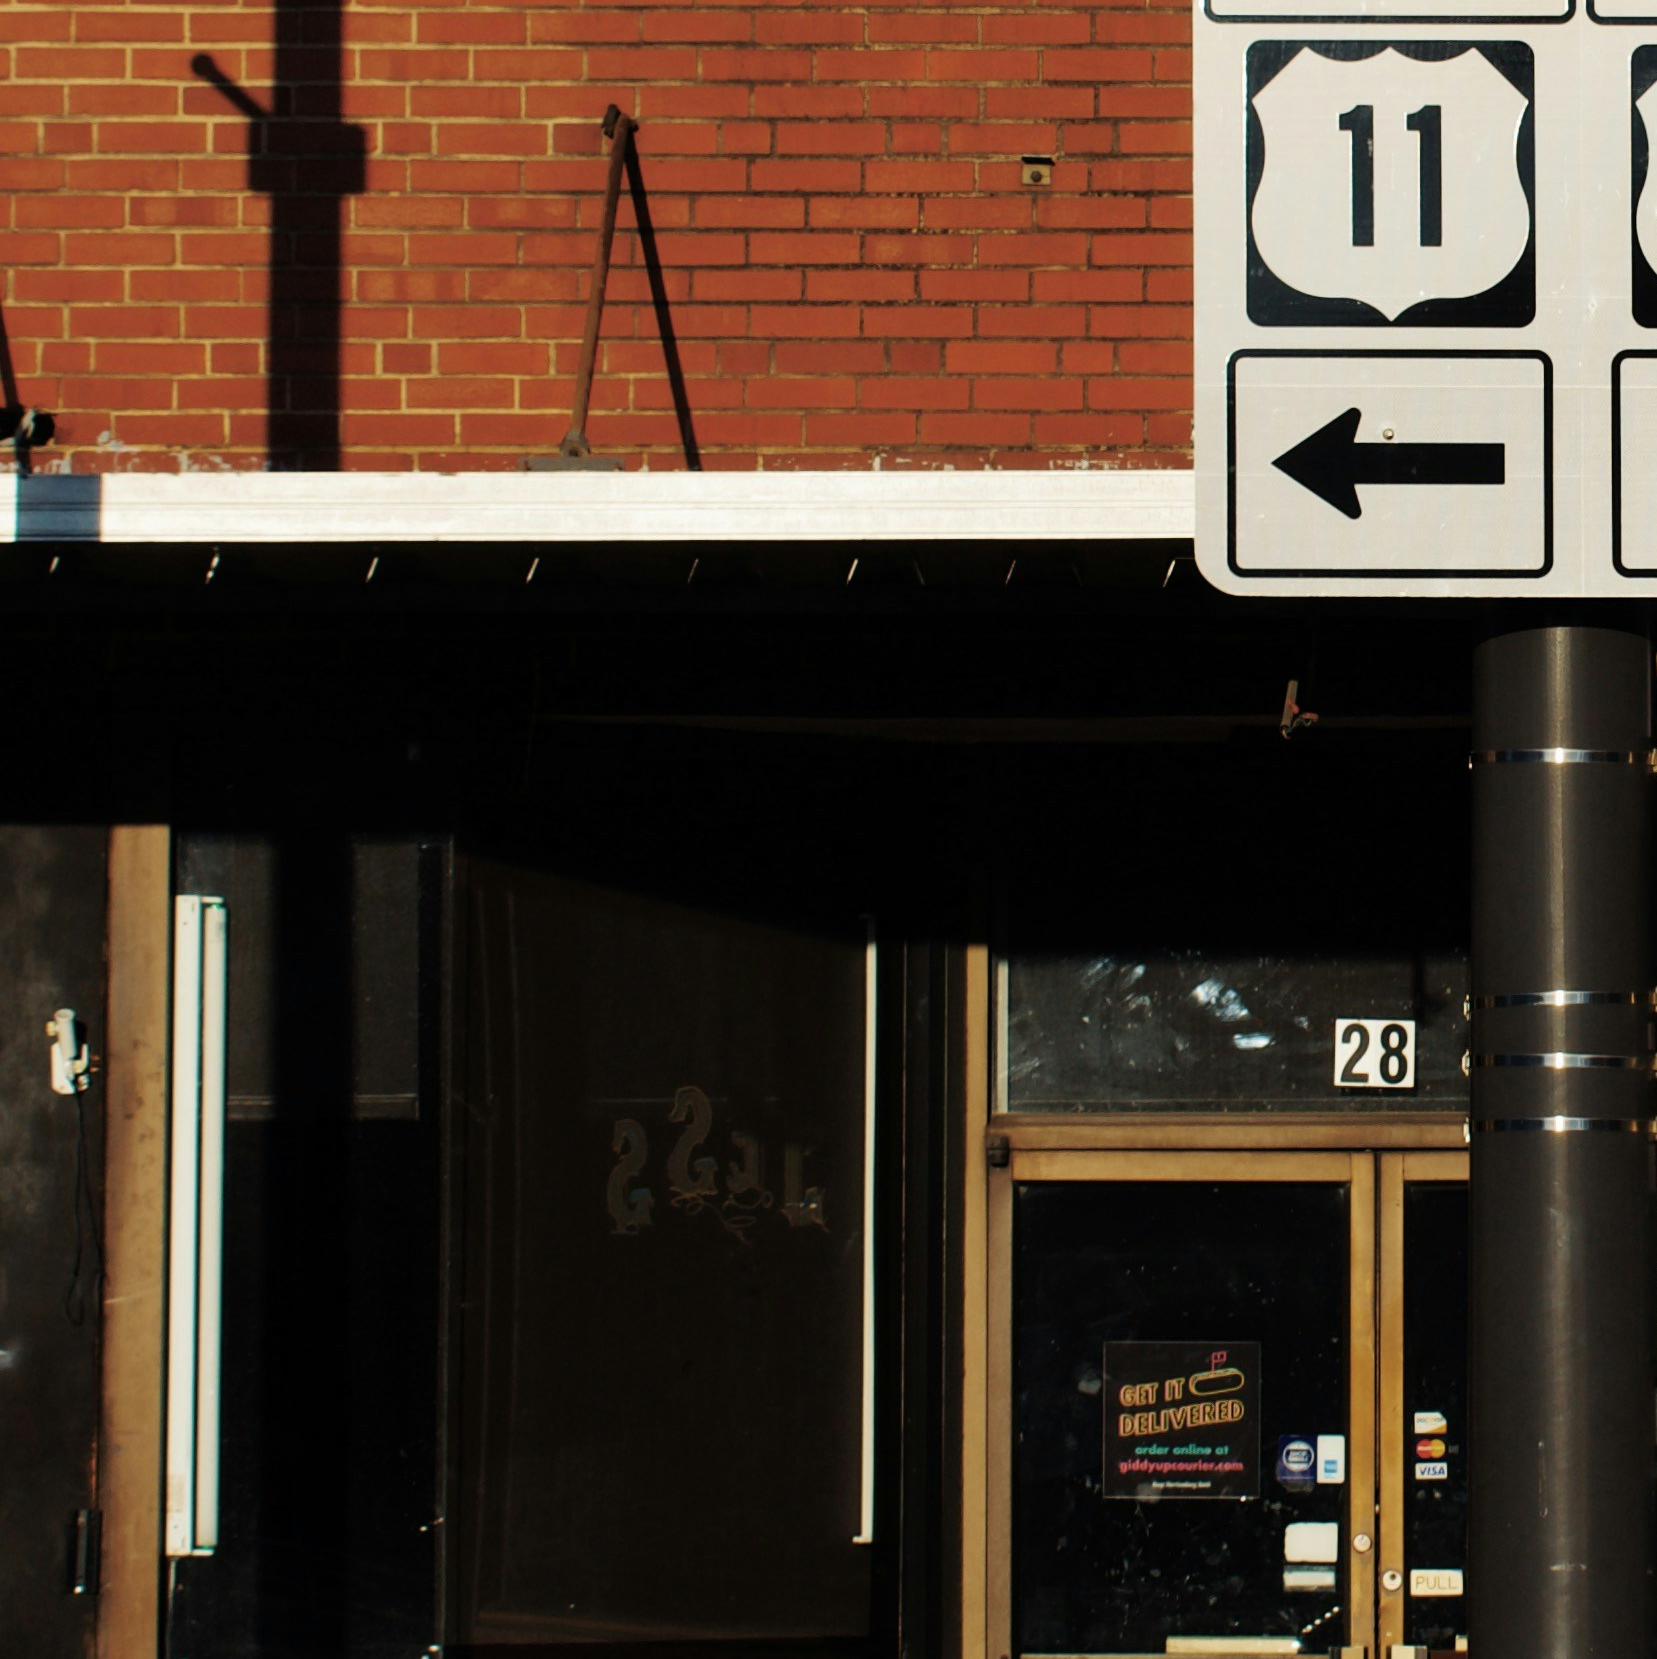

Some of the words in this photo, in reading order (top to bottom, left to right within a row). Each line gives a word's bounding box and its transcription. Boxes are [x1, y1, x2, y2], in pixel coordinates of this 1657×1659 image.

[1337, 104, 1443, 248] 11
[1339, 1023, 1409, 1085] 28
[1119, 1381, 1159, 1407] GET
[1164, 1377, 1186, 1402] IT
[1118, 1398, 1245, 1437] DELIVERED
[1135, 1444, 1169, 1455] order
[1173, 1443, 1211, 1455] online
[1215, 1445, 1229, 1455] at
[1420, 1465, 1445, 1476] VISA
[1415, 1575, 1458, 1590] PULL
